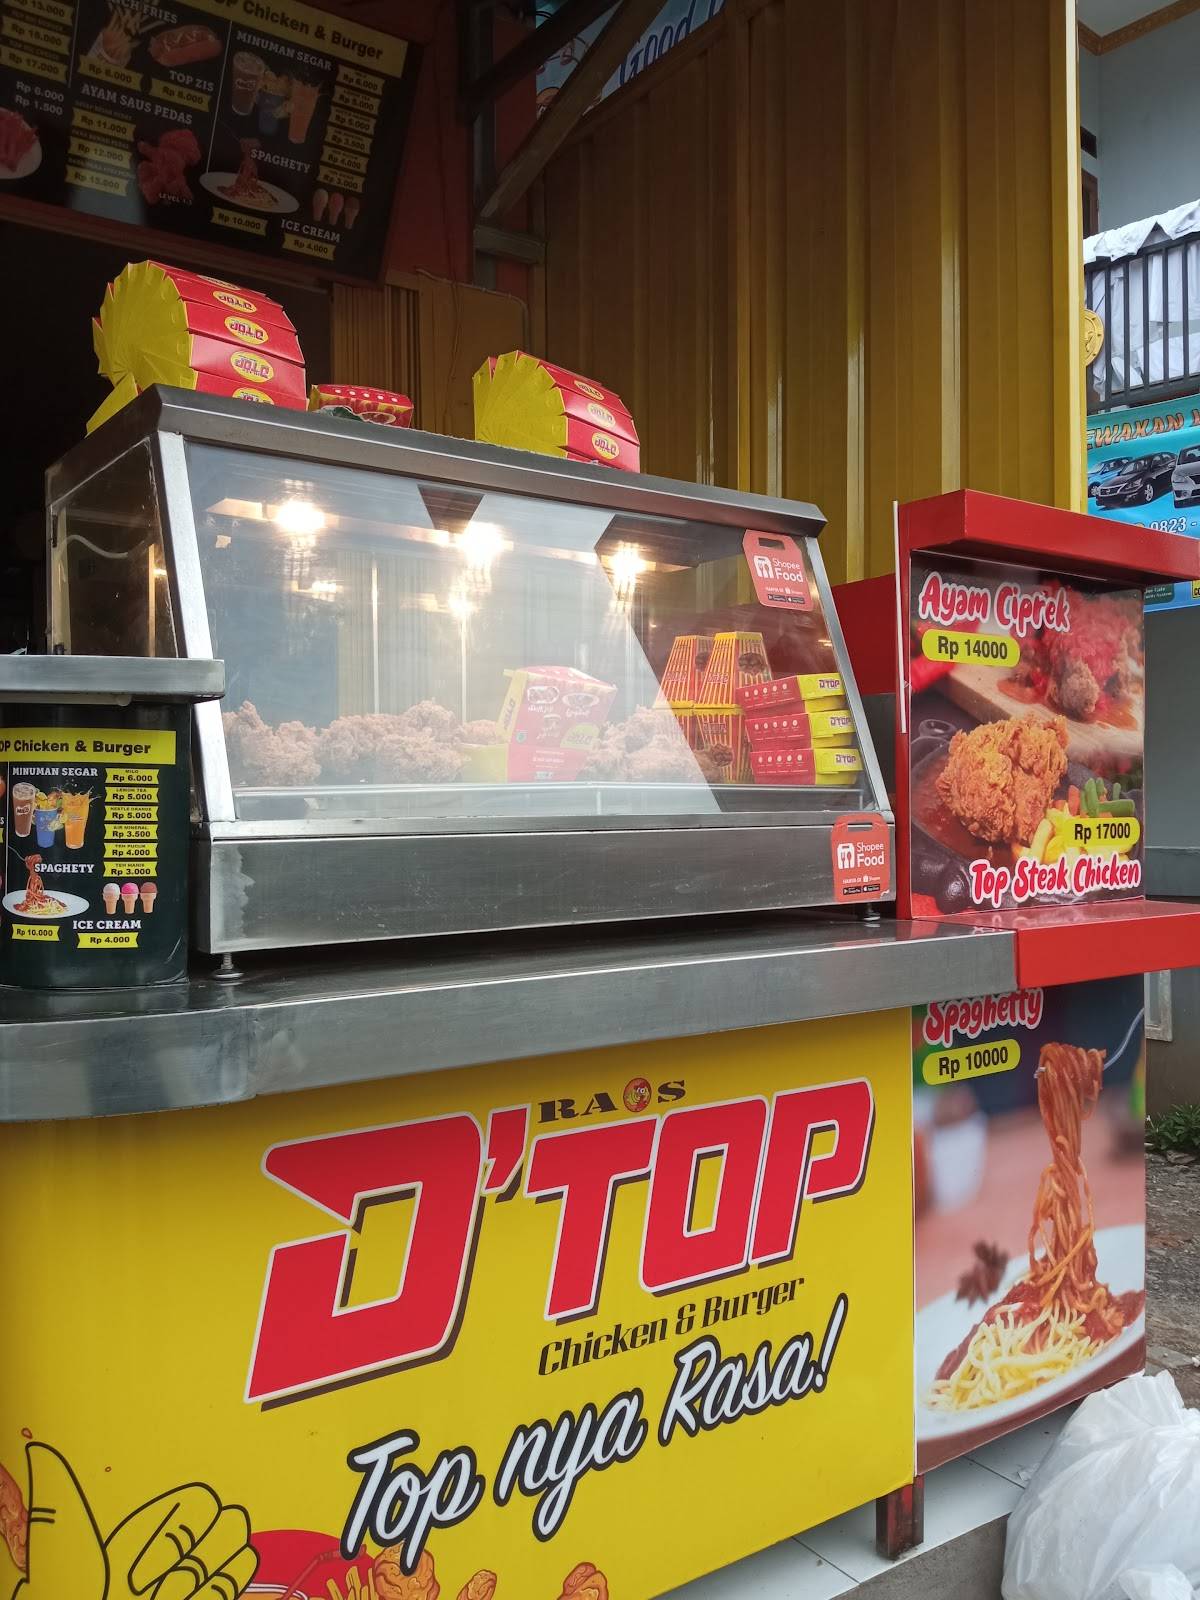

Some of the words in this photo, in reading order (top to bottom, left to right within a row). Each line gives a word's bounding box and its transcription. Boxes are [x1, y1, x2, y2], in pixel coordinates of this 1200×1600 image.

[143, 5, 178, 24] FRIES
[242, 0, 309, 34] Chicken
[314, 25, 326, 40] &
[331, 31, 383, 59] Burger
[236, 30, 295, 59] MINUMAN
[295, 50, 333, 71] SEGAR
[9, 53, 23, 64] Rp
[88, 64, 102, 75] Rp
[169, 70, 193, 85] TOP
[16, 81, 31, 93] Rp
[161, 86, 175, 97] Rp
[15, 94, 30, 107] Rp
[81, 83, 118, 103] AYAM
[120, 95, 151, 112] SAUS
[154, 104, 193, 125] PEDAS
[81, 116, 93, 126] Rp
[78, 144, 90, 153] Rp
[250, 148, 311, 173] SPAGHETY
[218, 213, 230, 223] Rp
[233, 217, 261, 230] 10.000
[280, 219, 301, 232] ICE
[302, 224, 341, 243] CREAM
[294, 239, 305, 249] Rp
[772, 557, 800, 571] Shopee
[774, 567, 804, 583] Food
[918, 571, 991, 626] Ayam
[993, 581, 1070, 638] Ciprek
[937, 635, 959, 660] Rp
[964, 638, 1008, 660] 14000
[14, 739, 69, 752] Chicken
[74, 740, 87, 752] &
[93, 740, 152, 756] Burger
[12, 767, 60, 776] MINUMAN
[61, 767, 98, 777] SEGAR
[112, 793, 124, 801] Rp
[1074, 823, 1092, 844] Rp
[1096, 822, 1131, 840] 17000
[112, 849, 123, 857] Rp
[856, 841, 885, 853] Shopee
[856, 851, 885, 867] Food
[34, 863, 94, 874] SPAGHETY
[111, 868, 123, 876] Rp
[969, 858, 1011, 908] Top
[1011, 855, 1070, 904] Steak
[1071, 852, 1142, 896] Chicken
[73, 920, 95, 930] ICE
[96, 919, 141, 930] CREAM
[16, 928, 26, 937] Rp
[27, 928, 53, 937] 10.000
[90, 936, 102, 944] Rp
[922, 987, 1044, 1048] Spaghetty
[939, 1056, 960, 1079] Rp
[965, 1046, 1008, 1071] 10000
[245, 1076, 875, 1412] D'TOP
[538, 1317, 668, 1376] Chicken
[675, 1303, 696, 1335] &
[701, 1277, 805, 1329] Burger
[339, 1428, 486, 1574] Top
[493, 1387, 649, 1542] nya
[658, 1292, 849, 1446] Rasa!
